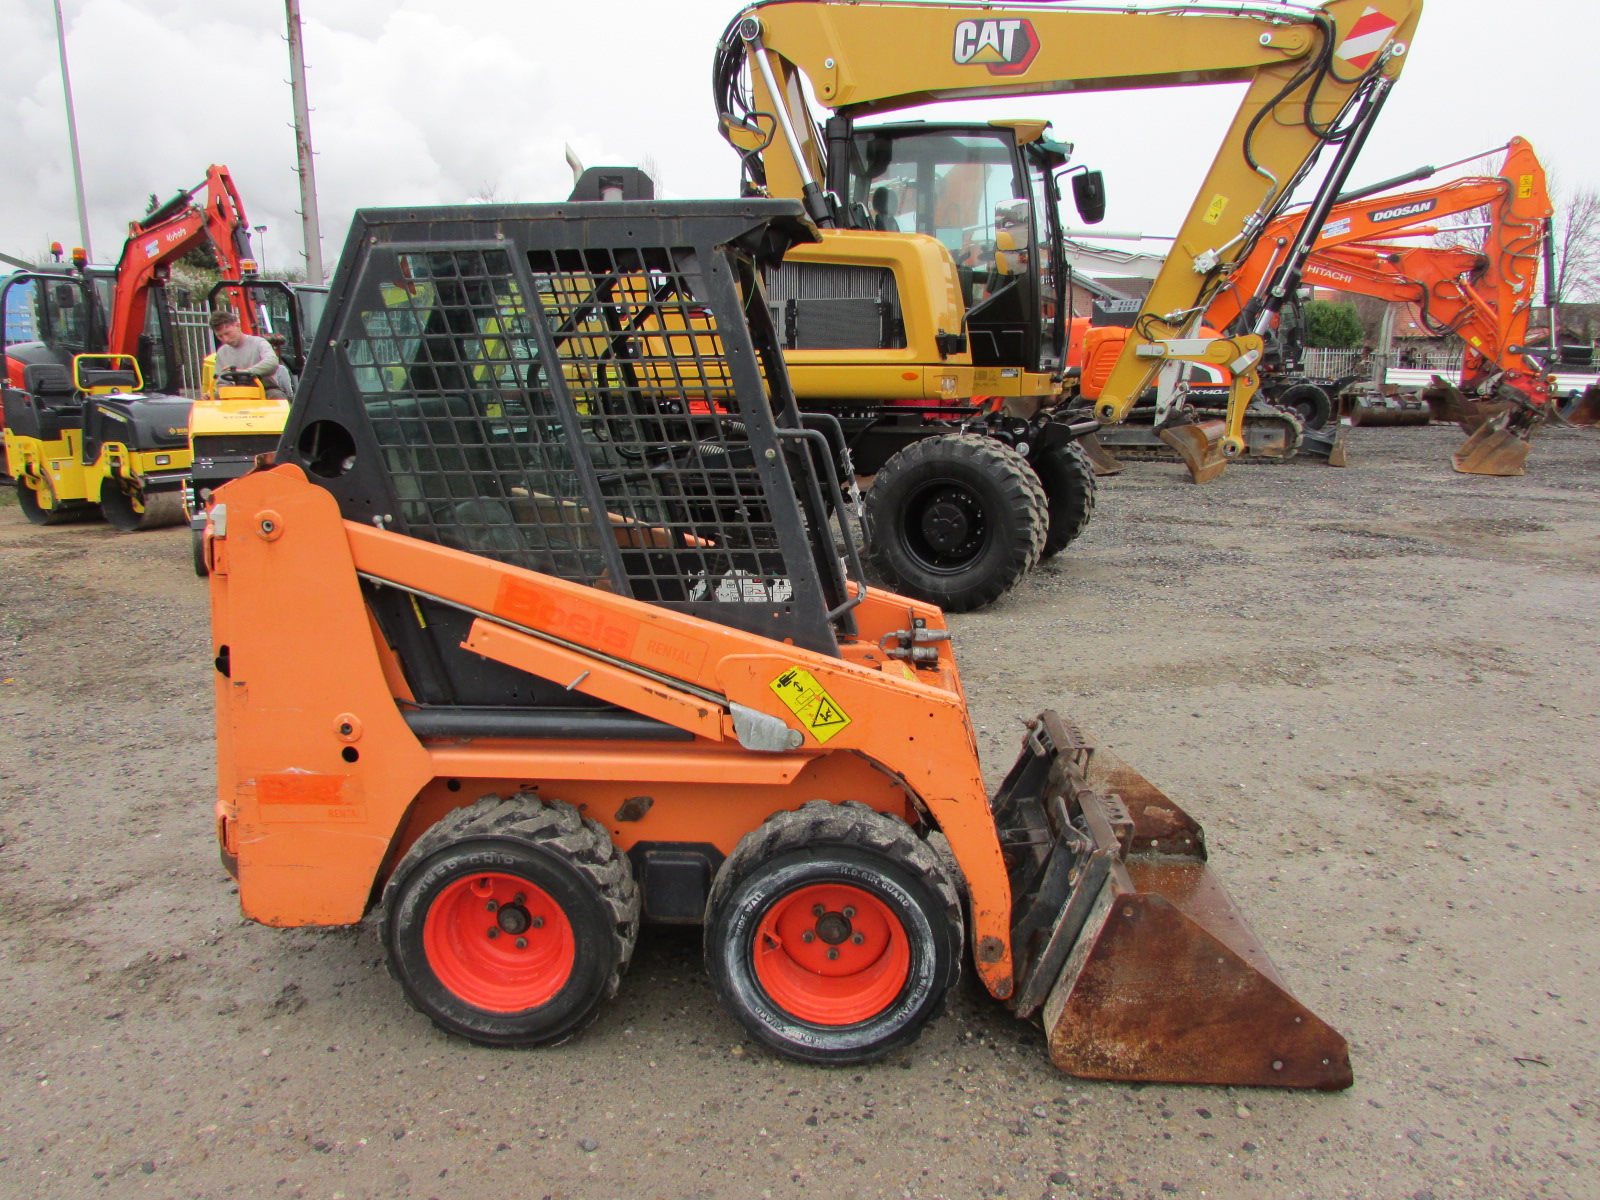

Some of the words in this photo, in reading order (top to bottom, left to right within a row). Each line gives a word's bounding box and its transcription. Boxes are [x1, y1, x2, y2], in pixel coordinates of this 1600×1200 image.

[955, 20, 1020, 63] CAT
[1373, 202, 1431, 222] DOOSAN
[1307, 265, 1352, 283] HITACHI
[503, 584, 629, 650] Boels
[648, 639, 693, 666] RENTAL
[880, 878, 910, 908] GUARD
